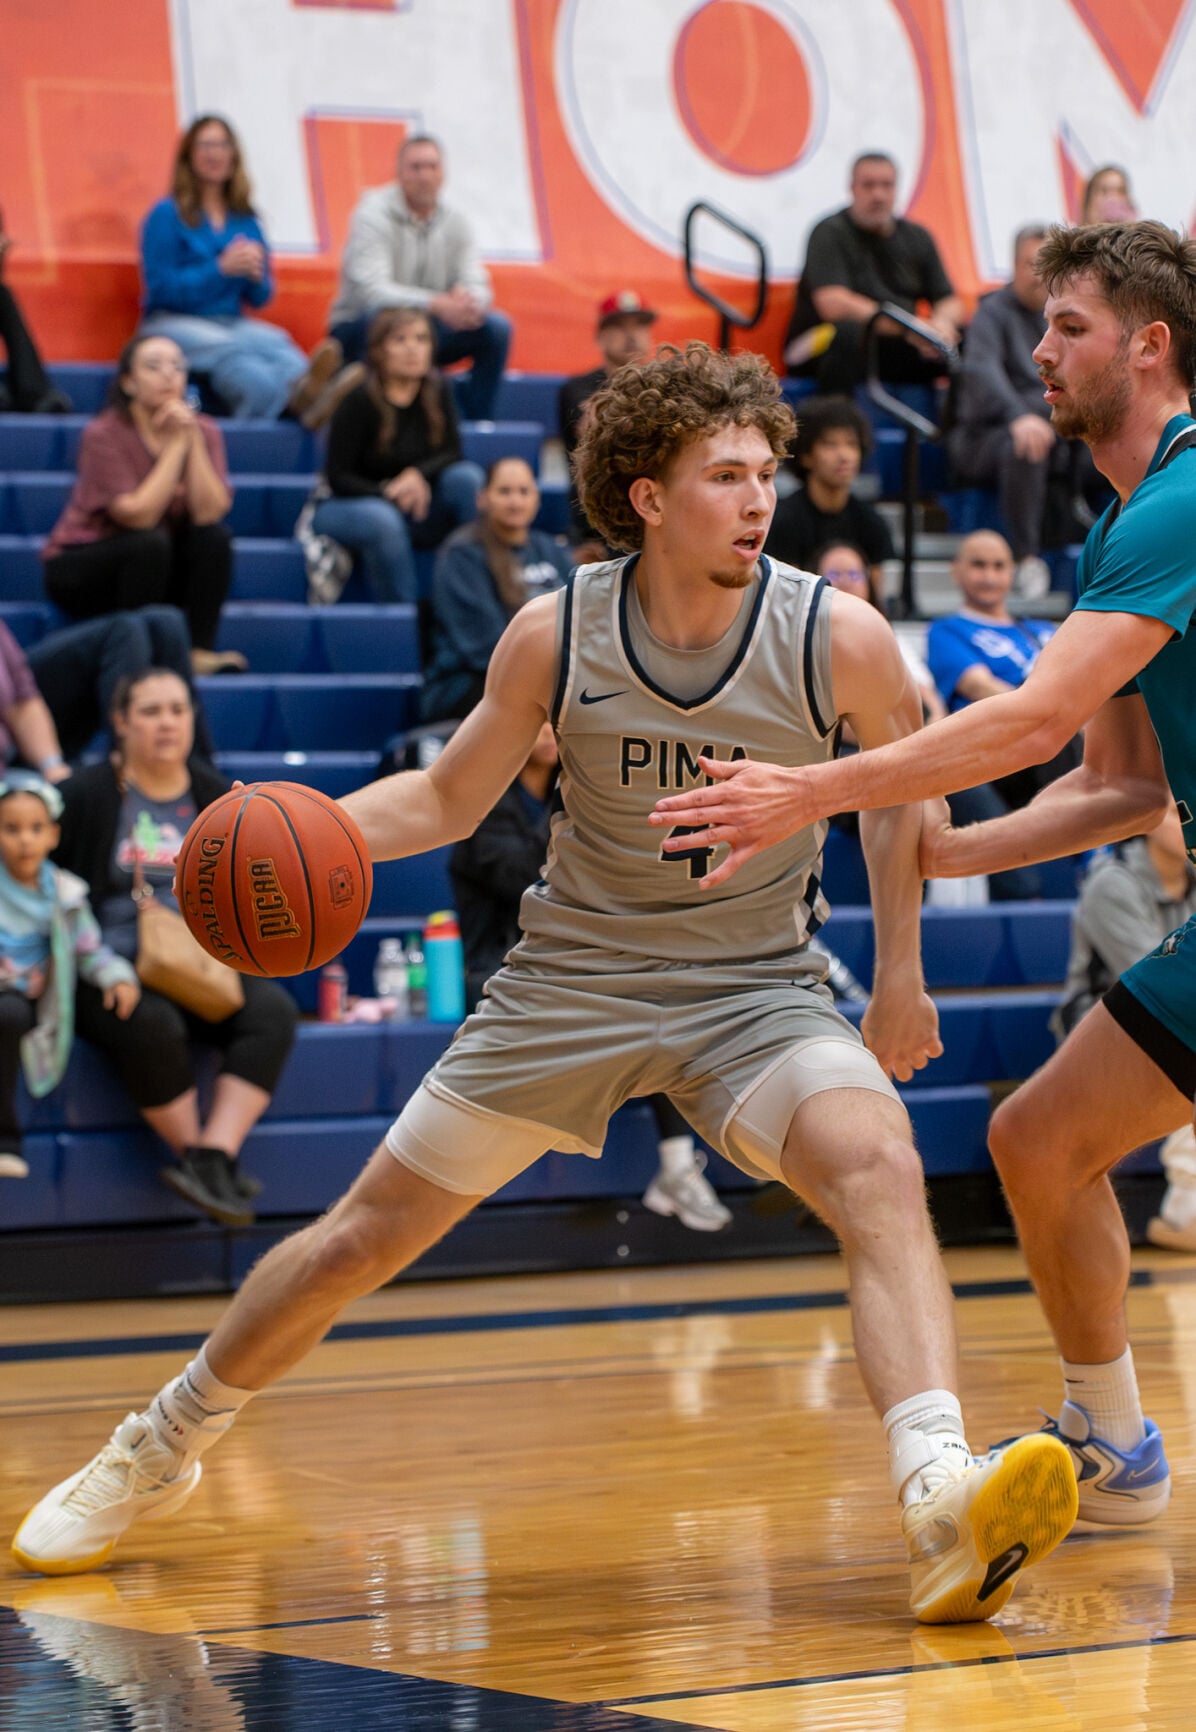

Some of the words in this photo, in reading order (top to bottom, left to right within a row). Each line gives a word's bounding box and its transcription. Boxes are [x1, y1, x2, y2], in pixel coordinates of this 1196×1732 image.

[658, 823, 718, 880] 4
[198, 837, 243, 961] SPALDING
[250, 858, 301, 942] NJCAA
